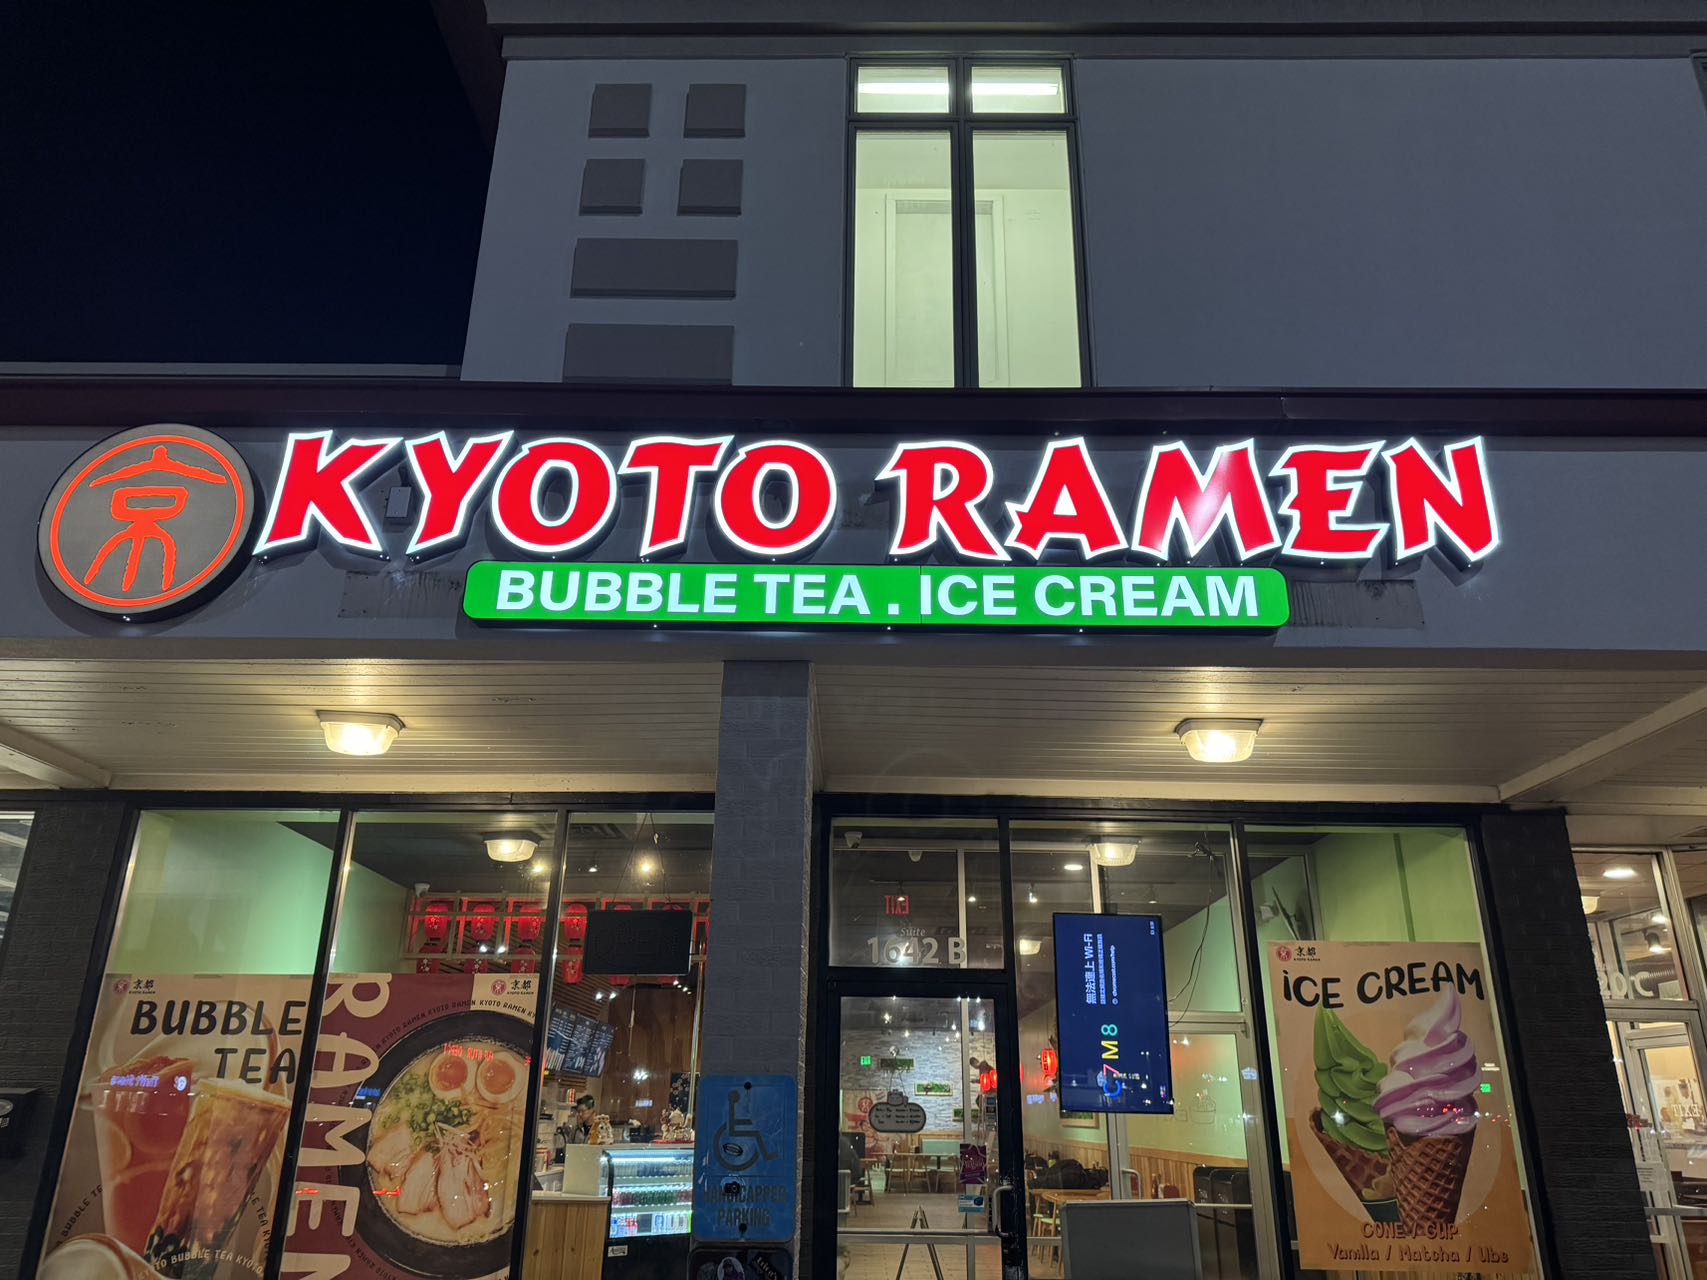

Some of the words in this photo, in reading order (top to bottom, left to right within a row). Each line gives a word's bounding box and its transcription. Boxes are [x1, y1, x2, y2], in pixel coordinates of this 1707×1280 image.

[252, 429, 838, 558] KYOTO
[874, 436, 1502, 563] RAMEN
[496, 570, 737, 613] BUBBLE
[754, 574, 870, 615] TEA
[920, 575, 1017, 615] ICE
[1035, 575, 1258, 617] CREAM
[900, 927, 926, 937] Suite
[1083, 932, 1094, 960] Wi-Fi
[867, 936, 939, 965] 1642
[947, 936, 967, 965] B
[1356, 960, 1485, 1005] CREAM
[130, 999, 307, 1036] BUBBLE
[402, 1011, 427, 1028] RAMEN
[427, 1003, 450, 1016] KYOTO
[451, 999, 476, 1010] RAMEN
[479, 998, 502, 1007] KYOTO
[502, 1002, 526, 1015] RAMEN
[214, 1047, 296, 1085] TEA
[60, 1197, 91, 1237] BUBBLE
[256, 1206, 269, 1227] TEA
[717, 1207, 772, 1227] PARKING
[1361, 1221, 1405, 1239] CONE
[1425, 1221, 1459, 1241] CUP
[170, 1248, 211, 1264] BUBBLE
[215, 1249, 234, 1262] TEA
[235, 1254, 264, 1275] KYOTO
[1327, 1242, 1381, 1262] Vanilla
[1399, 1243, 1460, 1263] Matcha
[1478, 1246, 1510, 1264] Ube
